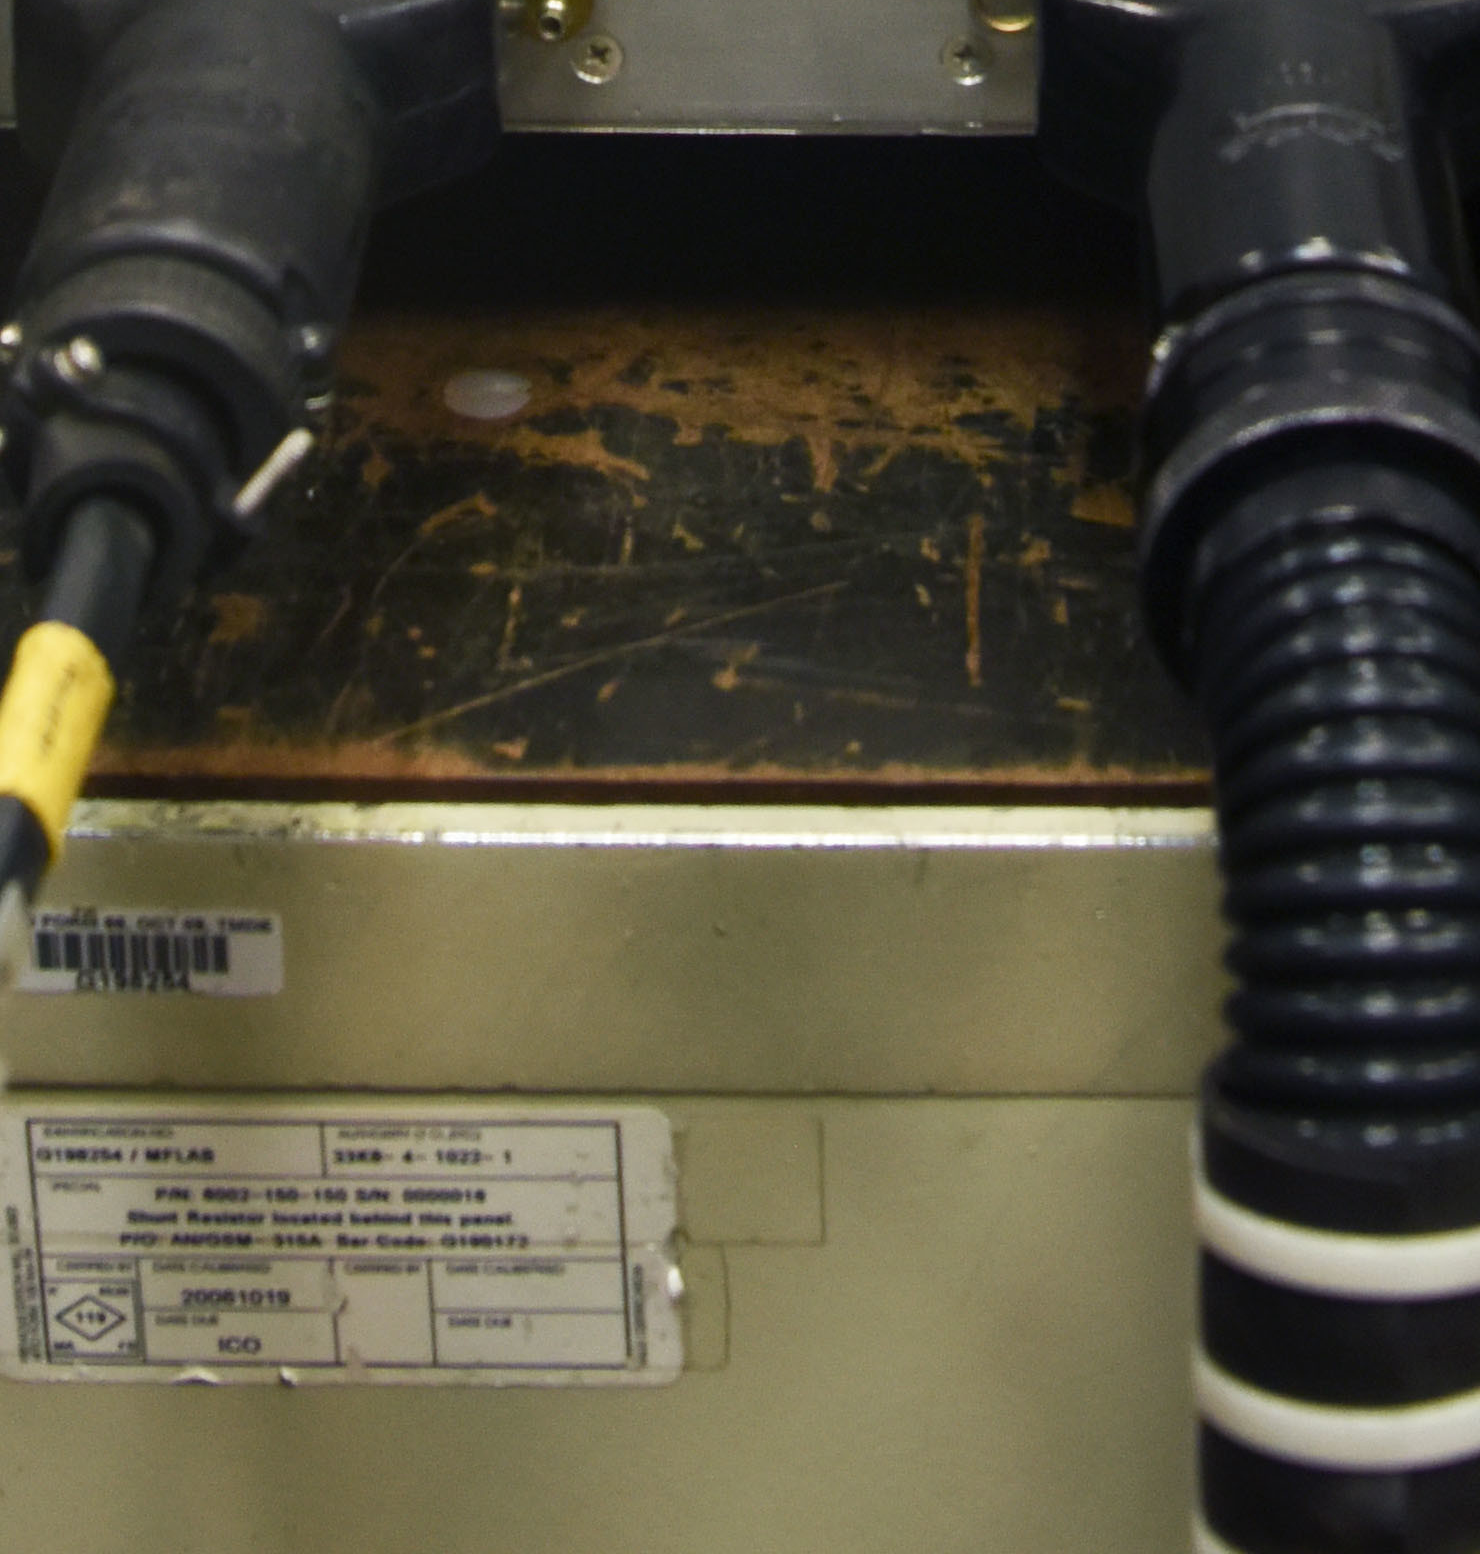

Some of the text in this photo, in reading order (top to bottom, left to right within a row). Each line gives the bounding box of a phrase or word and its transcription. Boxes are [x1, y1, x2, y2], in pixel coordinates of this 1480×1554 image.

[127, 1209, 178, 1225] Shunt
[186, 1210, 265, 1226] Resistor
[272, 1210, 343, 1226] located
[349, 1211, 413, 1227] behind
[419, 1211, 452, 1227] this
